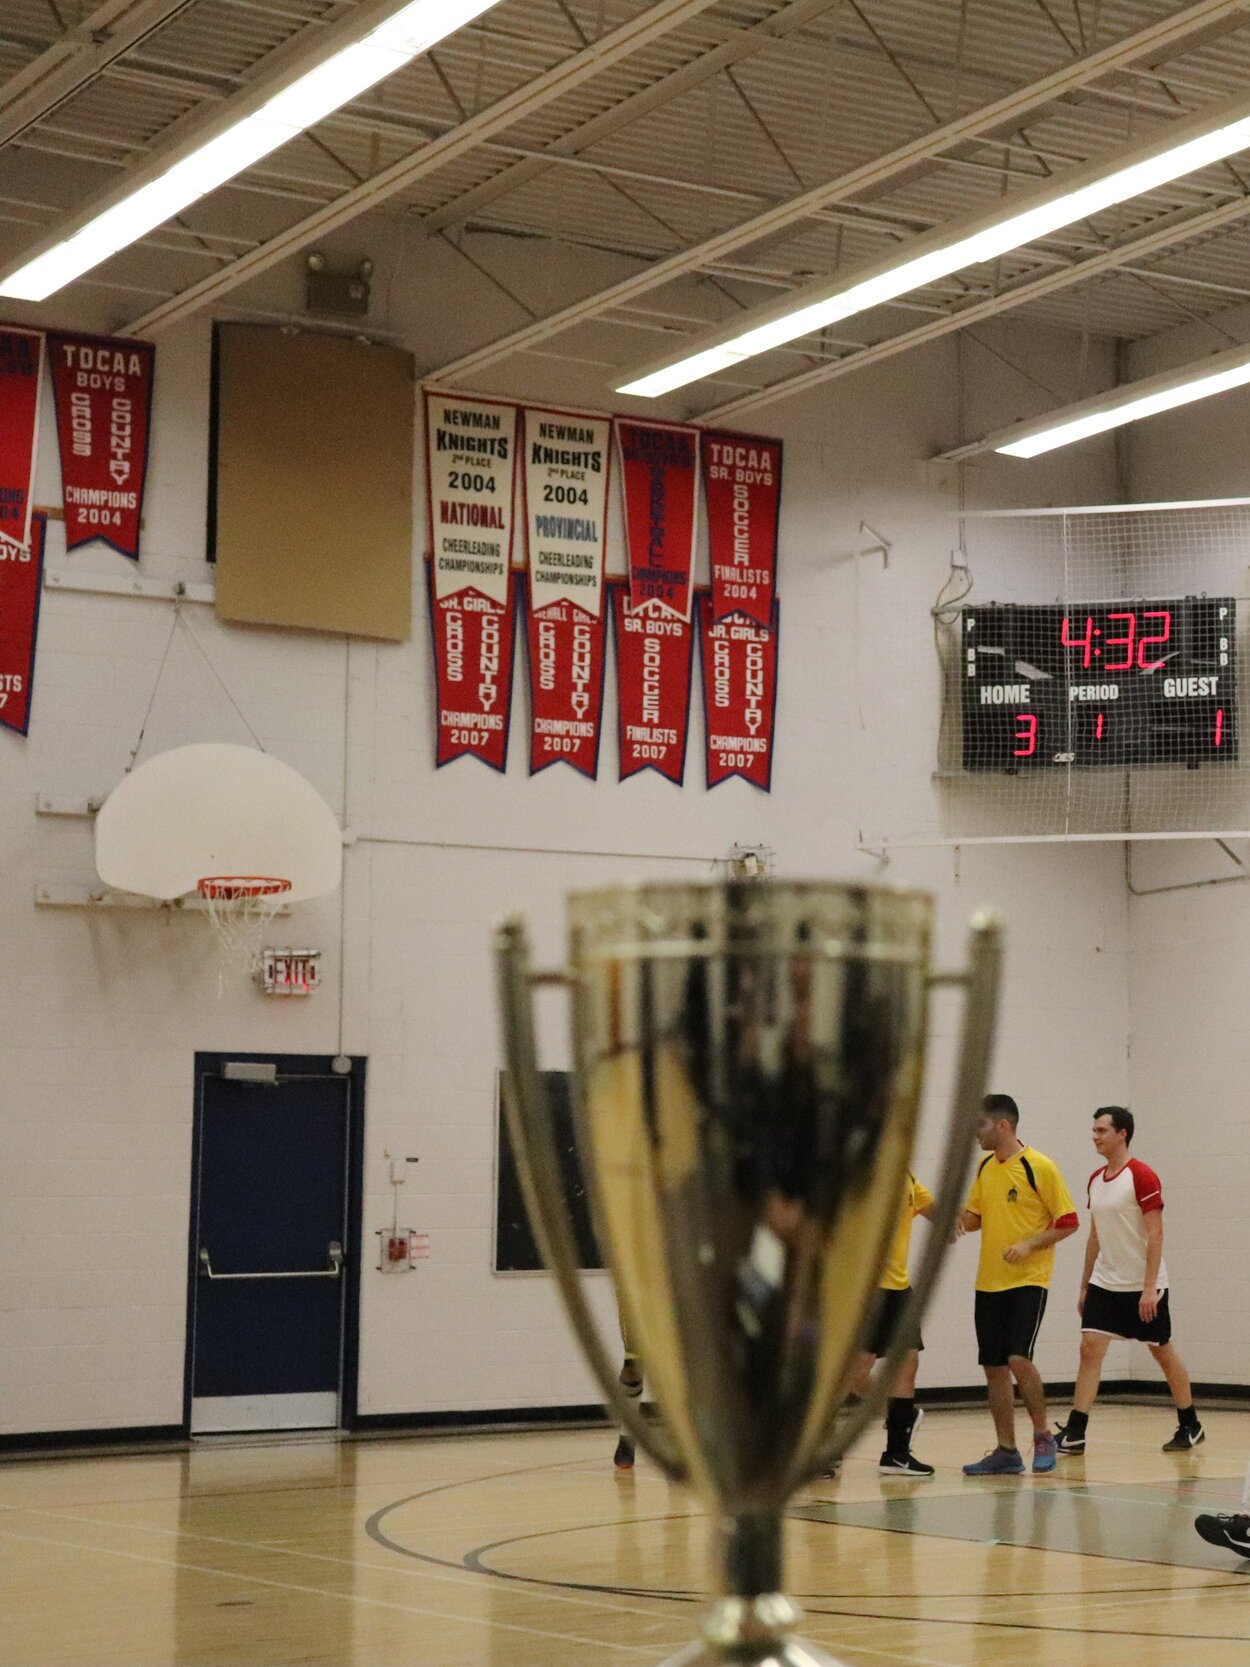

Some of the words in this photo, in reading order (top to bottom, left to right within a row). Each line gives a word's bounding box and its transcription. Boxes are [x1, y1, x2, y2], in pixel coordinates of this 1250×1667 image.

[62, 344, 141, 377] TDCAA
[77, 371, 125, 392] BOYS
[70, 392, 92, 457] CROSS
[443, 408, 500, 430] NEWMAN
[109, 398, 132, 485] COUNTRY
[436, 428, 508, 459] KNIGHTS
[539, 422, 594, 444] NEWMAN
[465, 455, 492, 468] PLACE
[531, 442, 601, 473] KNIGHTS
[710, 443, 772, 471] TDCAA
[448, 471, 496, 493] 2004
[560, 468, 586, 481] PLACE
[710, 465, 732, 481] SR.
[735, 468, 773, 486] BOYS
[65, 485, 137, 510] CHAMPIONS
[543, 484, 588, 505] 2004
[77, 507, 121, 526] 2004
[440, 501, 505, 529] NATIONAL
[733, 484, 750, 567] SOCCER
[535, 514, 598, 543] PROVINCIAL
[443, 538, 501, 557] CHEERLEADING
[438, 557, 504, 576] CHAMPIONSHIPS
[538, 551, 594, 569] CHEERLEADING
[535, 570, 597, 588] CHAMPIONSHIPS
[714, 564, 770, 585] FINALISTS
[723, 584, 757, 600] 2004
[1219, 607, 1228, 620] P
[624, 618, 645, 633] SR.
[646, 621, 683, 637] BOYS
[708, 625, 729, 639] JR.
[730, 626, 769, 643] GIRLS
[967, 618, 976, 632] P
[446, 612, 463, 682] CROSS
[1061, 611, 1171, 670] 4:32
[1219, 637, 1228, 651] B
[478, 615, 499, 712] COUNTRY
[539, 622, 555, 690] CROSS
[967, 648, 976, 661] B
[1219, 652, 1228, 666] B
[571, 625, 591, 719] COUNTRY
[643, 638, 660, 723] SOCCER
[714, 641, 730, 707] CROSS
[967, 663, 976, 677] B
[744, 643, 763, 735] COUNTRY
[980, 684, 1031, 705] HOME
[1069, 684, 1119, 701] PERIOD
[1163, 676, 1219, 698] GUEST
[441, 709, 503, 731] CHAMPIONS
[534, 718, 594, 739] CHAMPIONS
[1095, 713, 1104, 739] 1
[1214, 708, 1224, 746] 1
[450, 729, 489, 746] 2007
[543, 736, 581, 753] 2007
[626, 724, 678, 745] FINALISTS
[710, 734, 767, 753] CHAMPIONS
[1013, 714, 1038, 757] 3
[632, 744, 667, 760] 2007
[719, 752, 754, 768] 2007
[274, 958, 309, 985] EXIT
